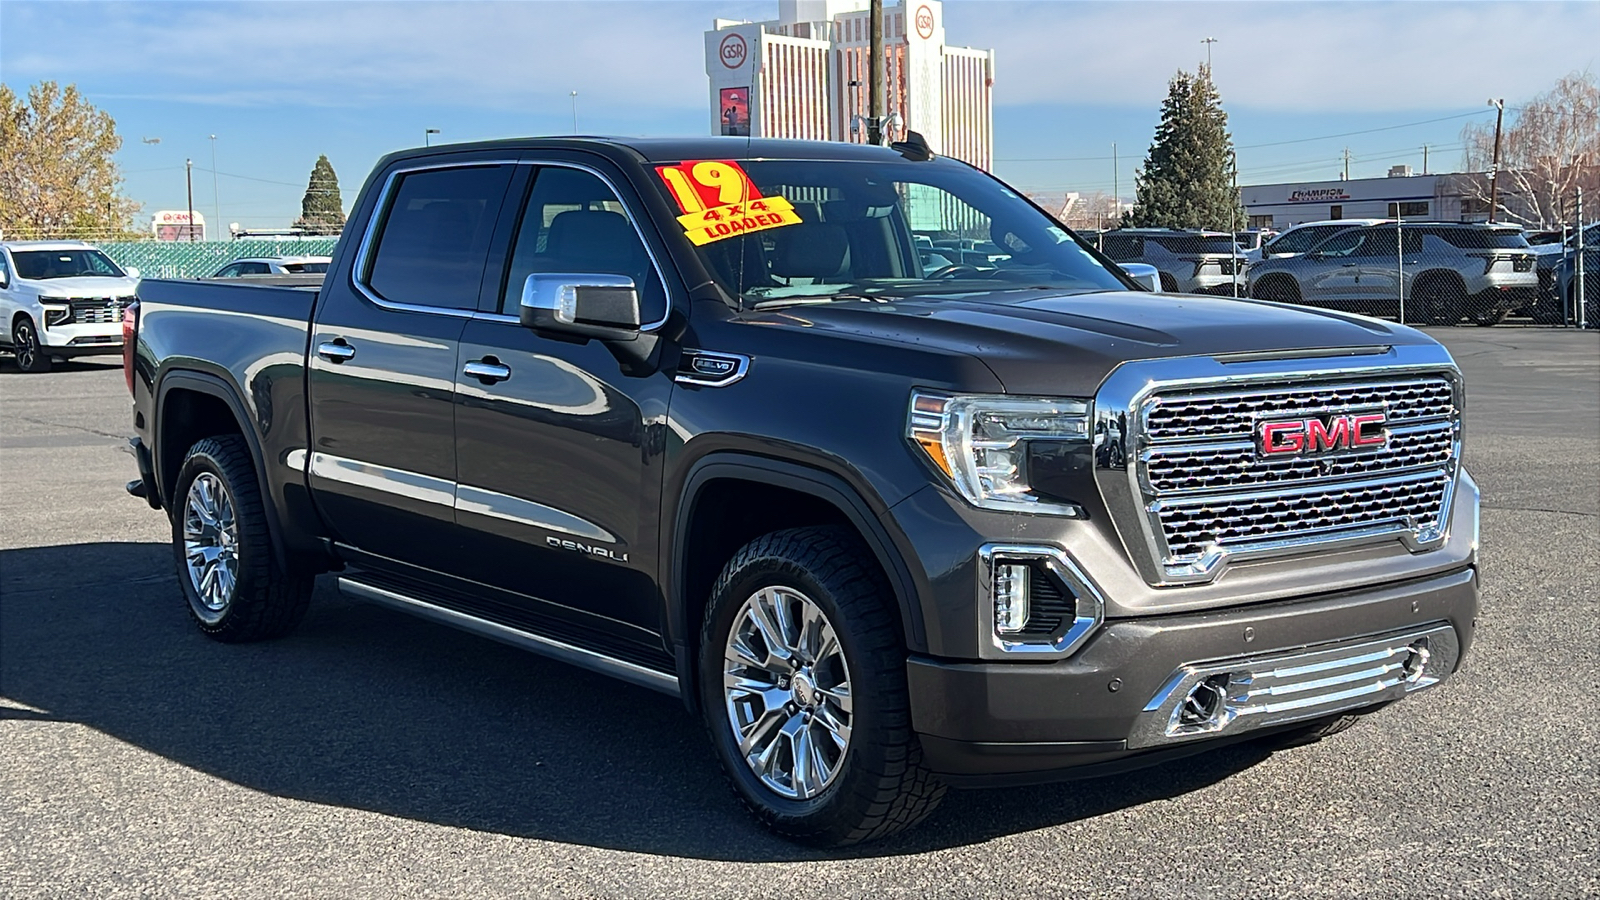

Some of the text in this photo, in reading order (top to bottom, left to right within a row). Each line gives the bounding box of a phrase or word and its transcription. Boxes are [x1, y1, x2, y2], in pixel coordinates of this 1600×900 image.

[917, 14, 932, 30] GSR
[722, 43, 743, 59] GSR
[662, 161, 747, 214] 19
[1291, 188, 1344, 200] CHAMPION
[704, 212, 784, 239] LOADED
[1262, 414, 1387, 456] GMC
[545, 535, 630, 563] DENALI
